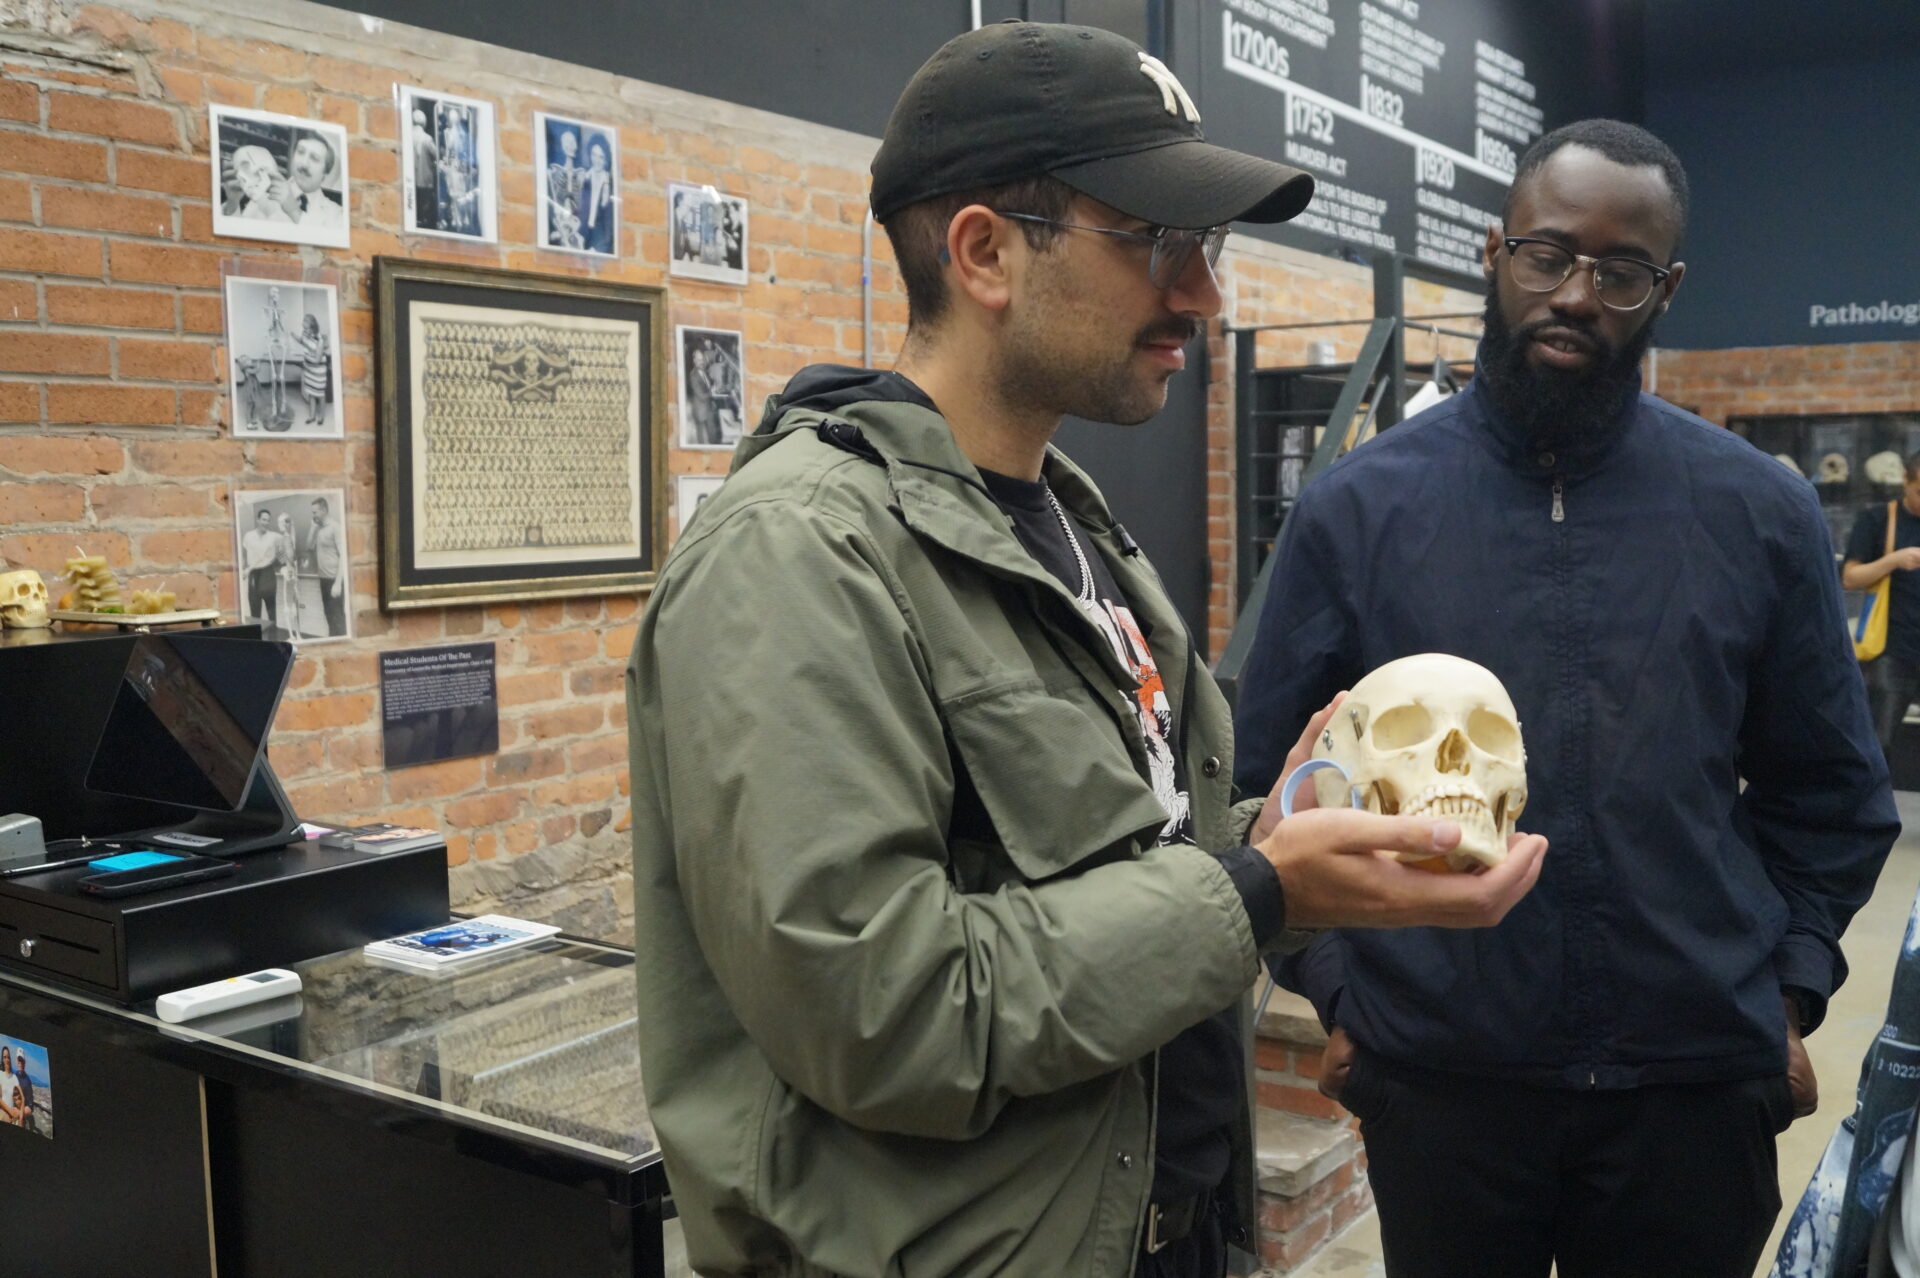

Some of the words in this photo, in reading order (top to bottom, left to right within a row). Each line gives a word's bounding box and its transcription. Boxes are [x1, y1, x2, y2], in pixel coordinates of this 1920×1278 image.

[1231, 21, 1290, 78] 1700s
[1291, 97, 1335, 144] 1752
[1367, 83, 1404, 126] 1832
[1285, 141, 1327, 170] MURDER
[1327, 155, 1347, 177] ACT
[1421, 148, 1456, 190] 1920
[1482, 135, 1517, 174] 1950s
[1335, 185, 1351, 205] THE
[1809, 300, 1920, 327] Patholog
[384, 657, 409, 667] Medical
[410, 655, 438, 664] Students
[439, 653, 447, 661] Of
[448, 652, 459, 660] The
